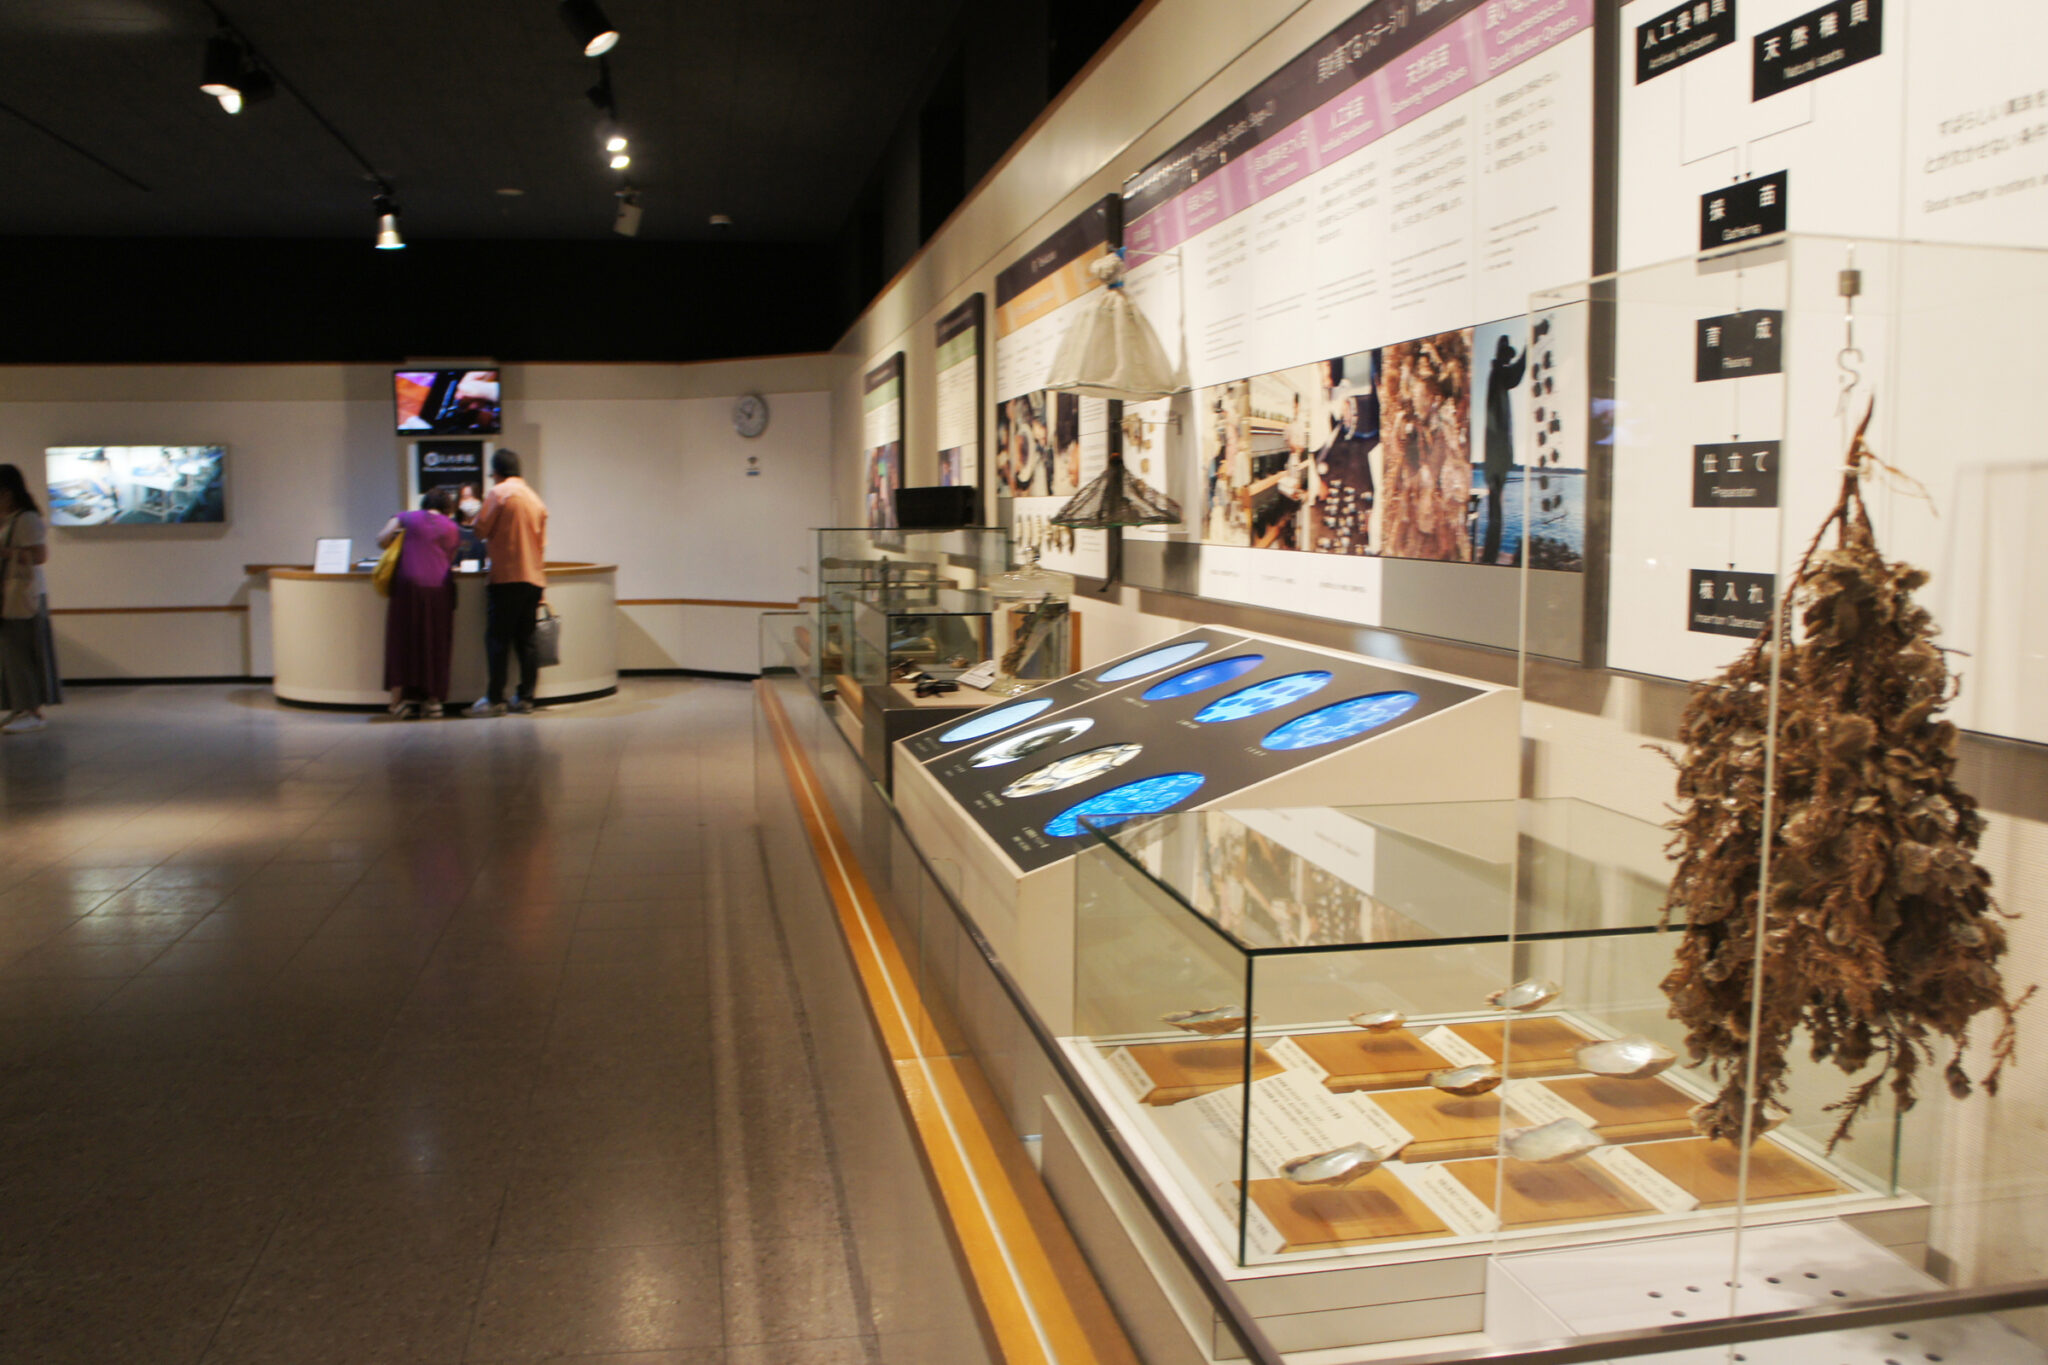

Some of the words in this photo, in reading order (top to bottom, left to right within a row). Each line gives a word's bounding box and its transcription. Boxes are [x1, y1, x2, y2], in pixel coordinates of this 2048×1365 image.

[1704, 317, 1773, 347] 育成
[1702, 452, 1769, 473] 仕立て
